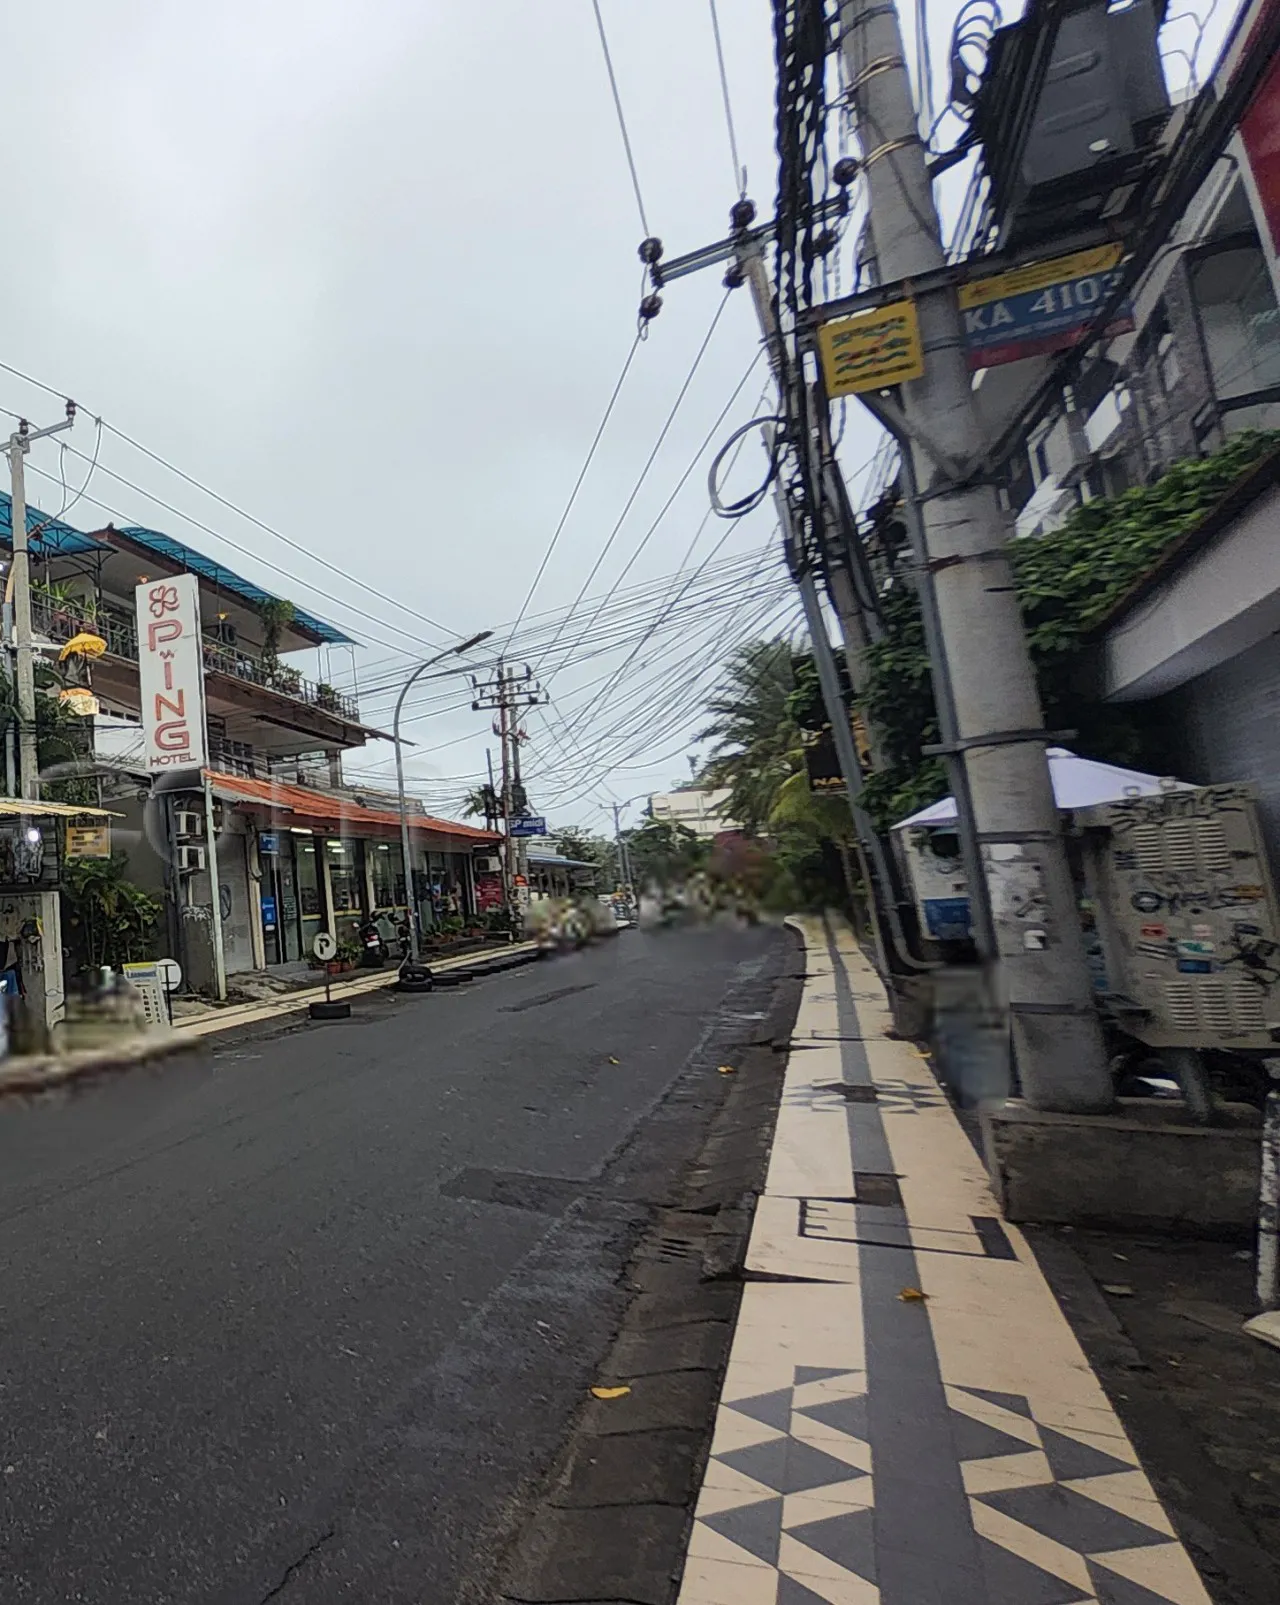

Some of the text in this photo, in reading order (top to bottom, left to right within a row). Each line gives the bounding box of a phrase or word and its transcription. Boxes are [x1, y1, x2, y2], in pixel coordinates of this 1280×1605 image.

[964, 302, 1015, 333] KA
[147, 619, 190, 751] PING
[149, 752, 197, 768] HOTEL
